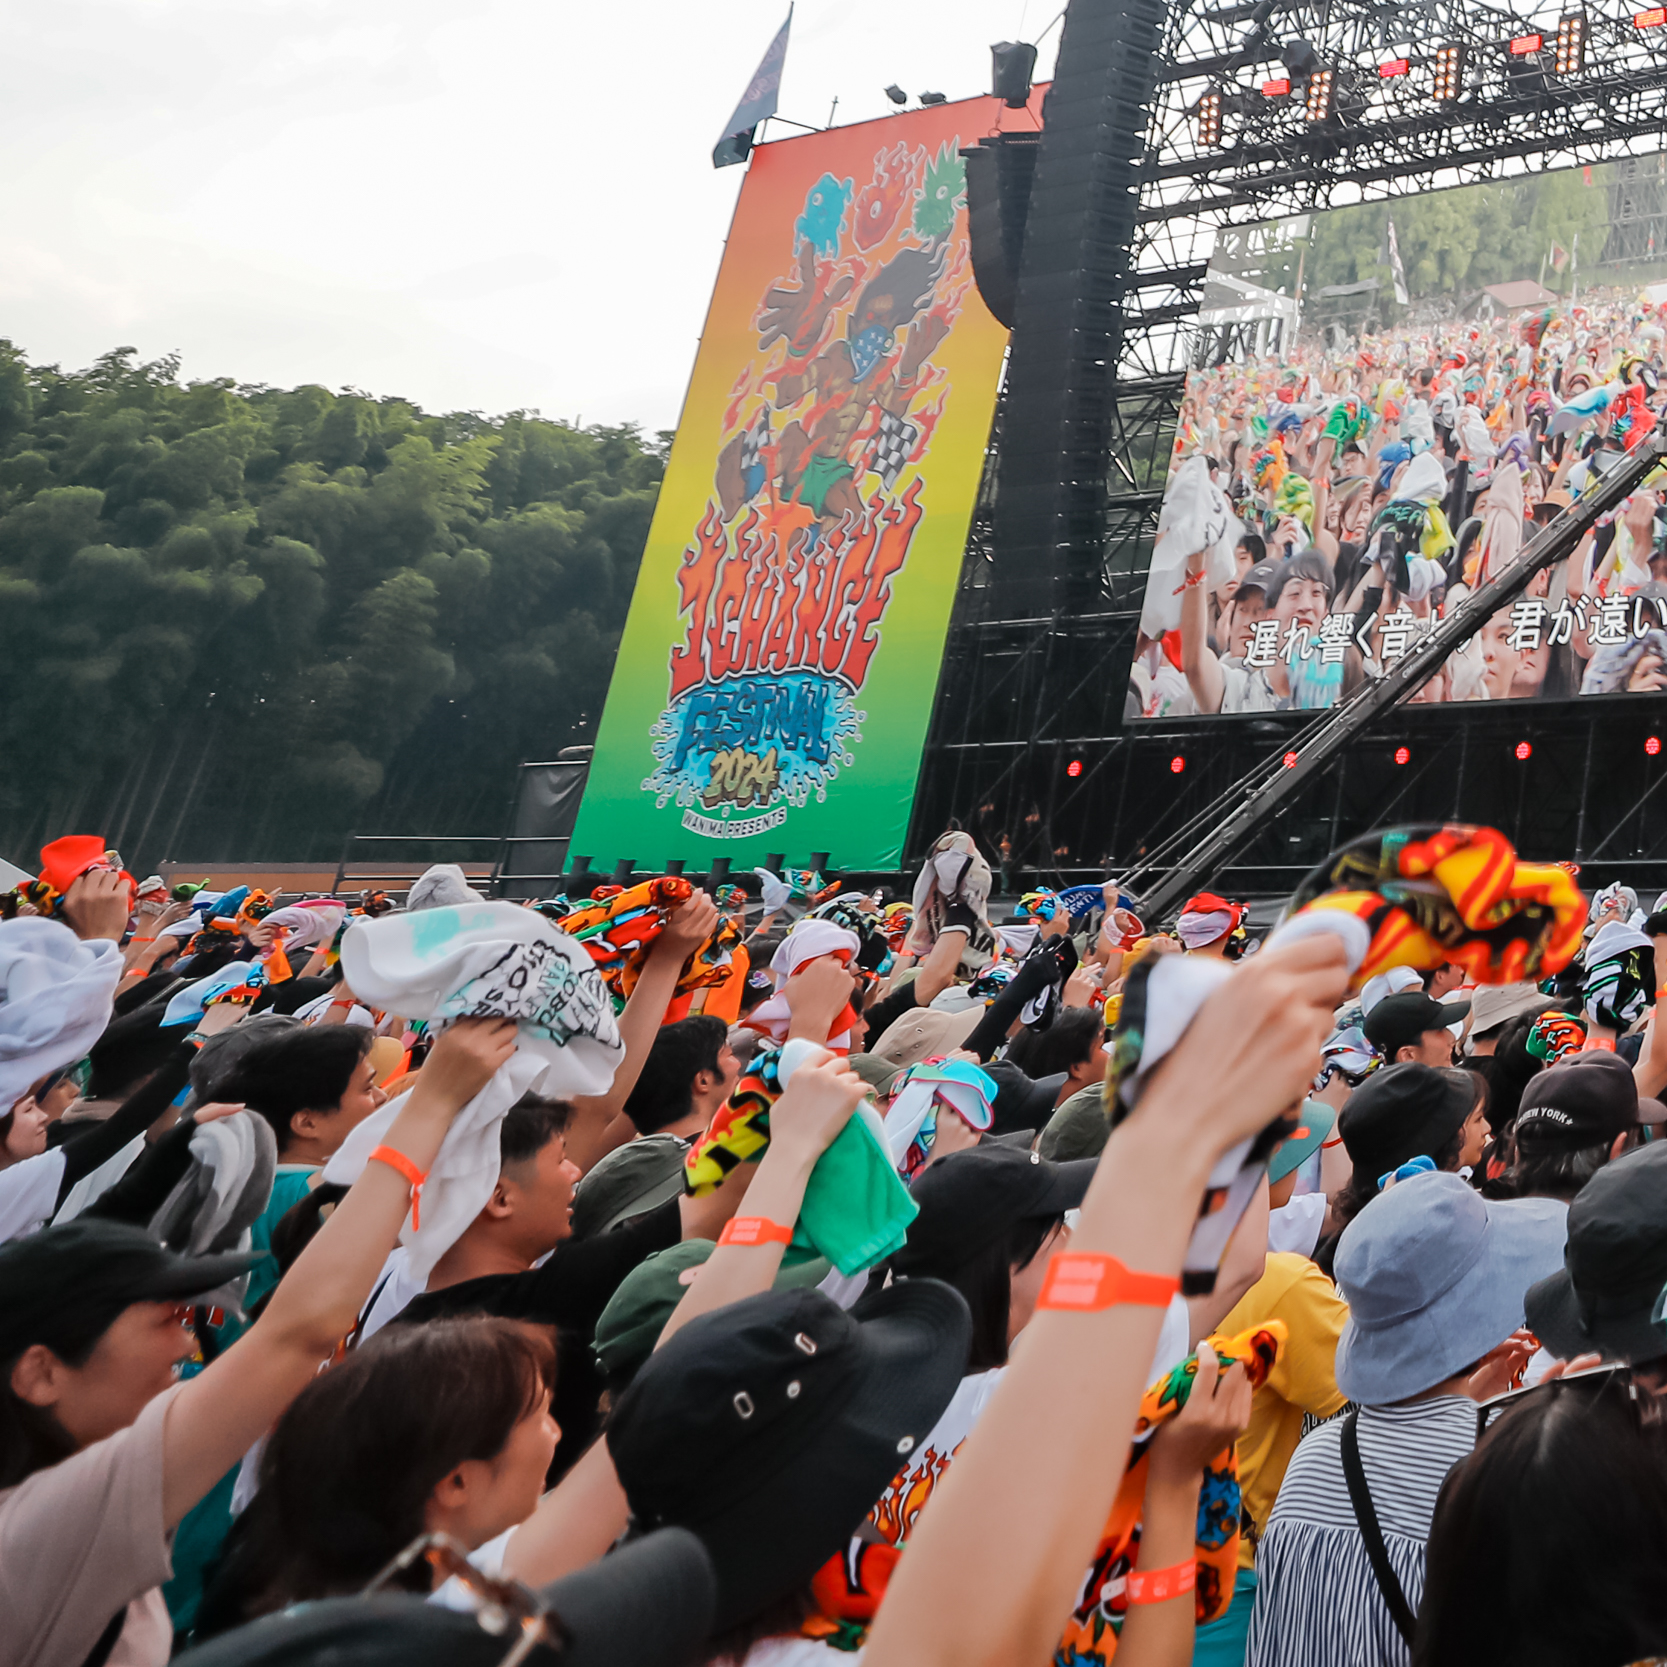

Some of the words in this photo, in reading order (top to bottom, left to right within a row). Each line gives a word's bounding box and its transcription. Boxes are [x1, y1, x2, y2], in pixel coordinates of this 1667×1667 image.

[669, 680, 830, 773] FESTIVAL
[703, 746, 780, 806] 2024
[682, 811, 726, 837] WANIMA
[726, 807, 787, 837] PRESENTS
[1522, 1107, 1539, 1122] NEW
[1540, 1107, 1568, 1124] YORK
